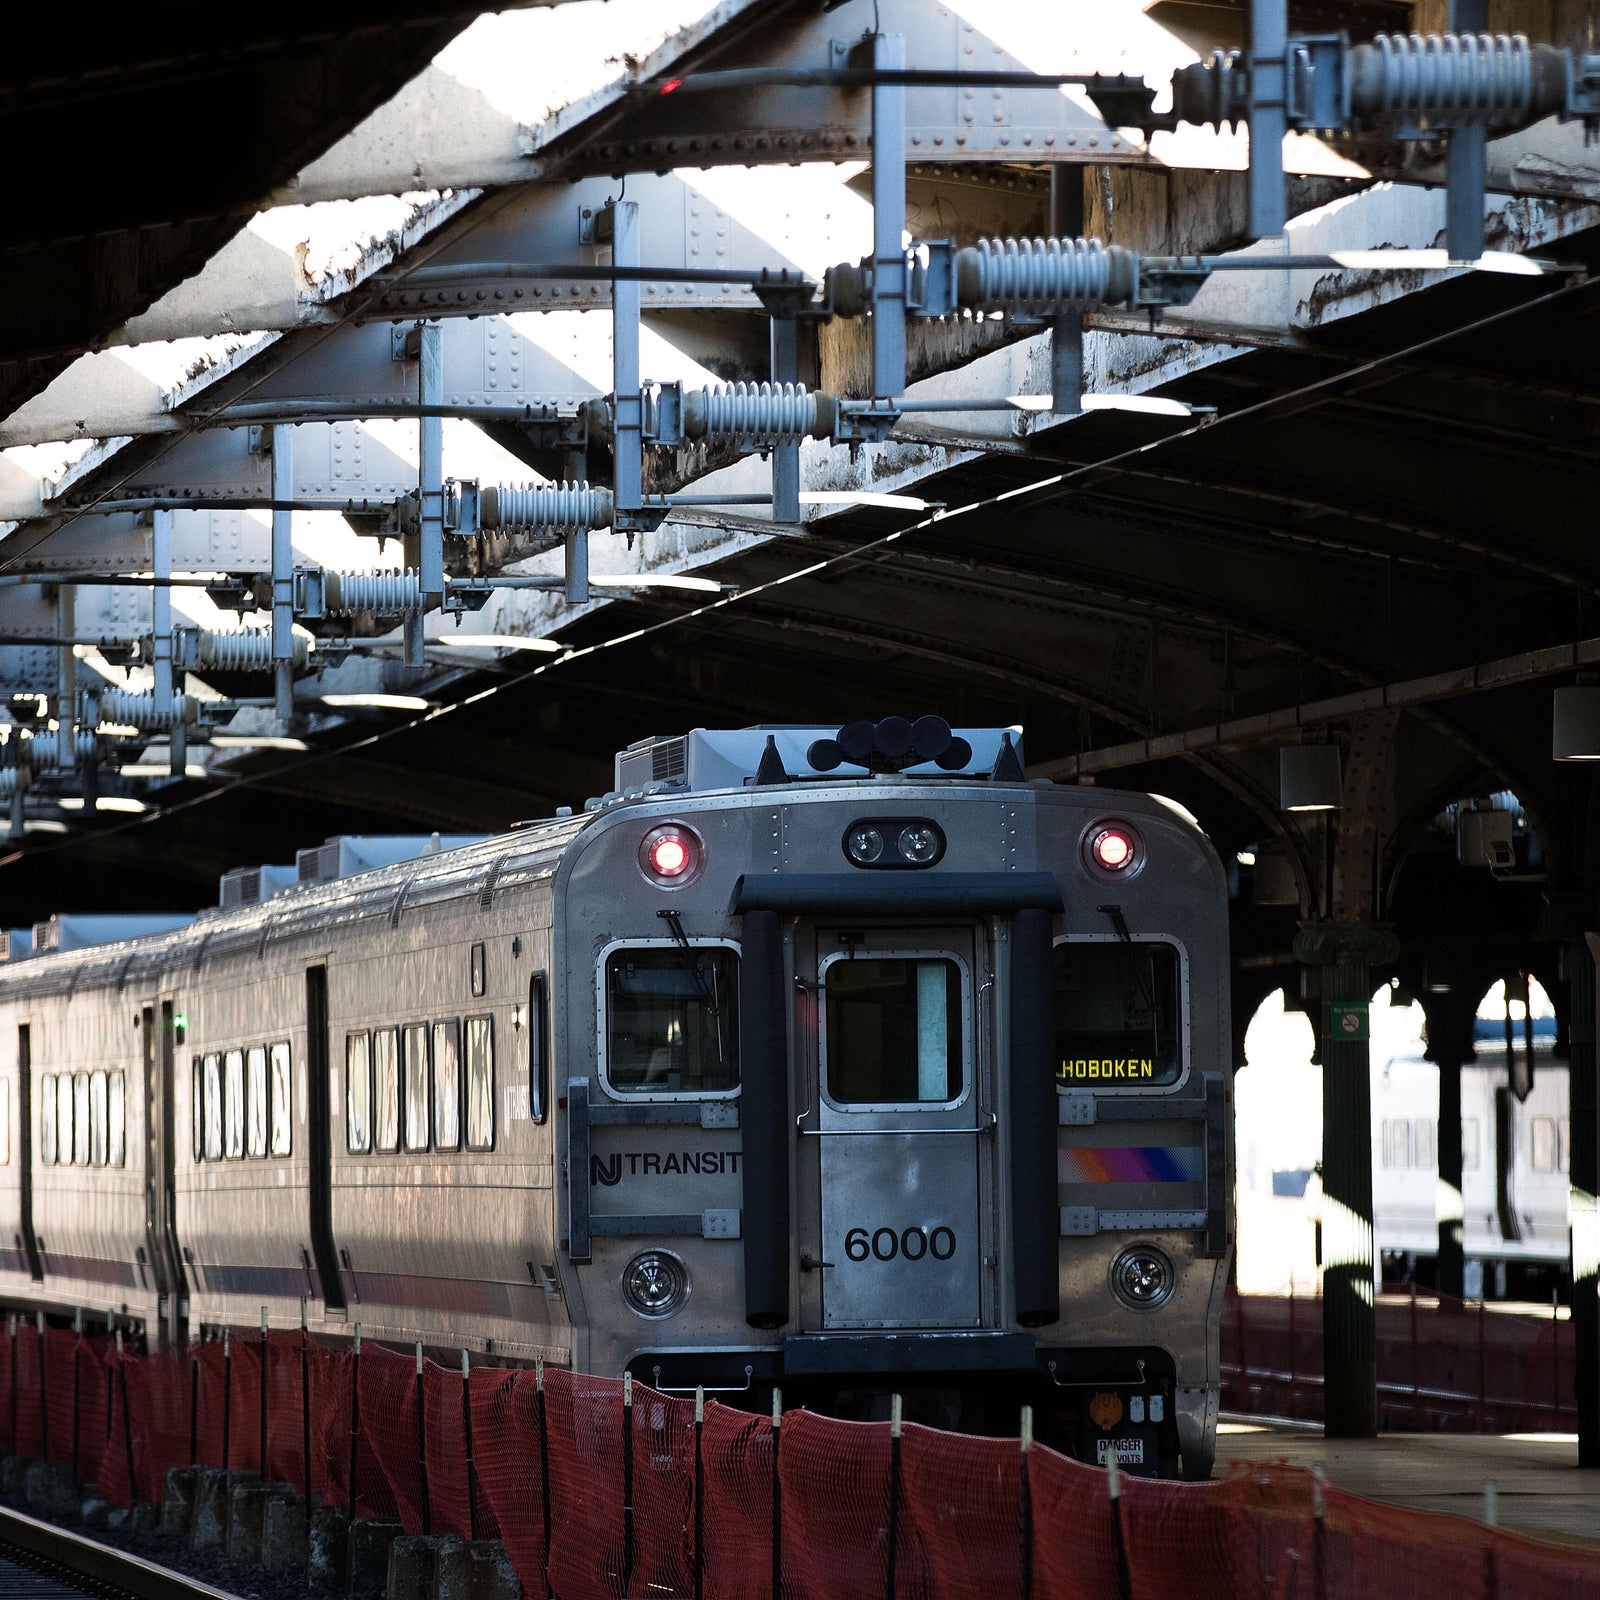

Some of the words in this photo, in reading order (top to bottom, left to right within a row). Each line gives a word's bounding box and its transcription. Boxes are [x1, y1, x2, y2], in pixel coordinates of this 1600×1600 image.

[1062, 1059, 1152, 1078] HOBOKEN
[625, 1151, 743, 1175] TRANSIT
[844, 1226, 957, 1262] 6000
[1100, 1440, 1141, 1451] DANGER
[1117, 1454, 1141, 1463] VOLTS
